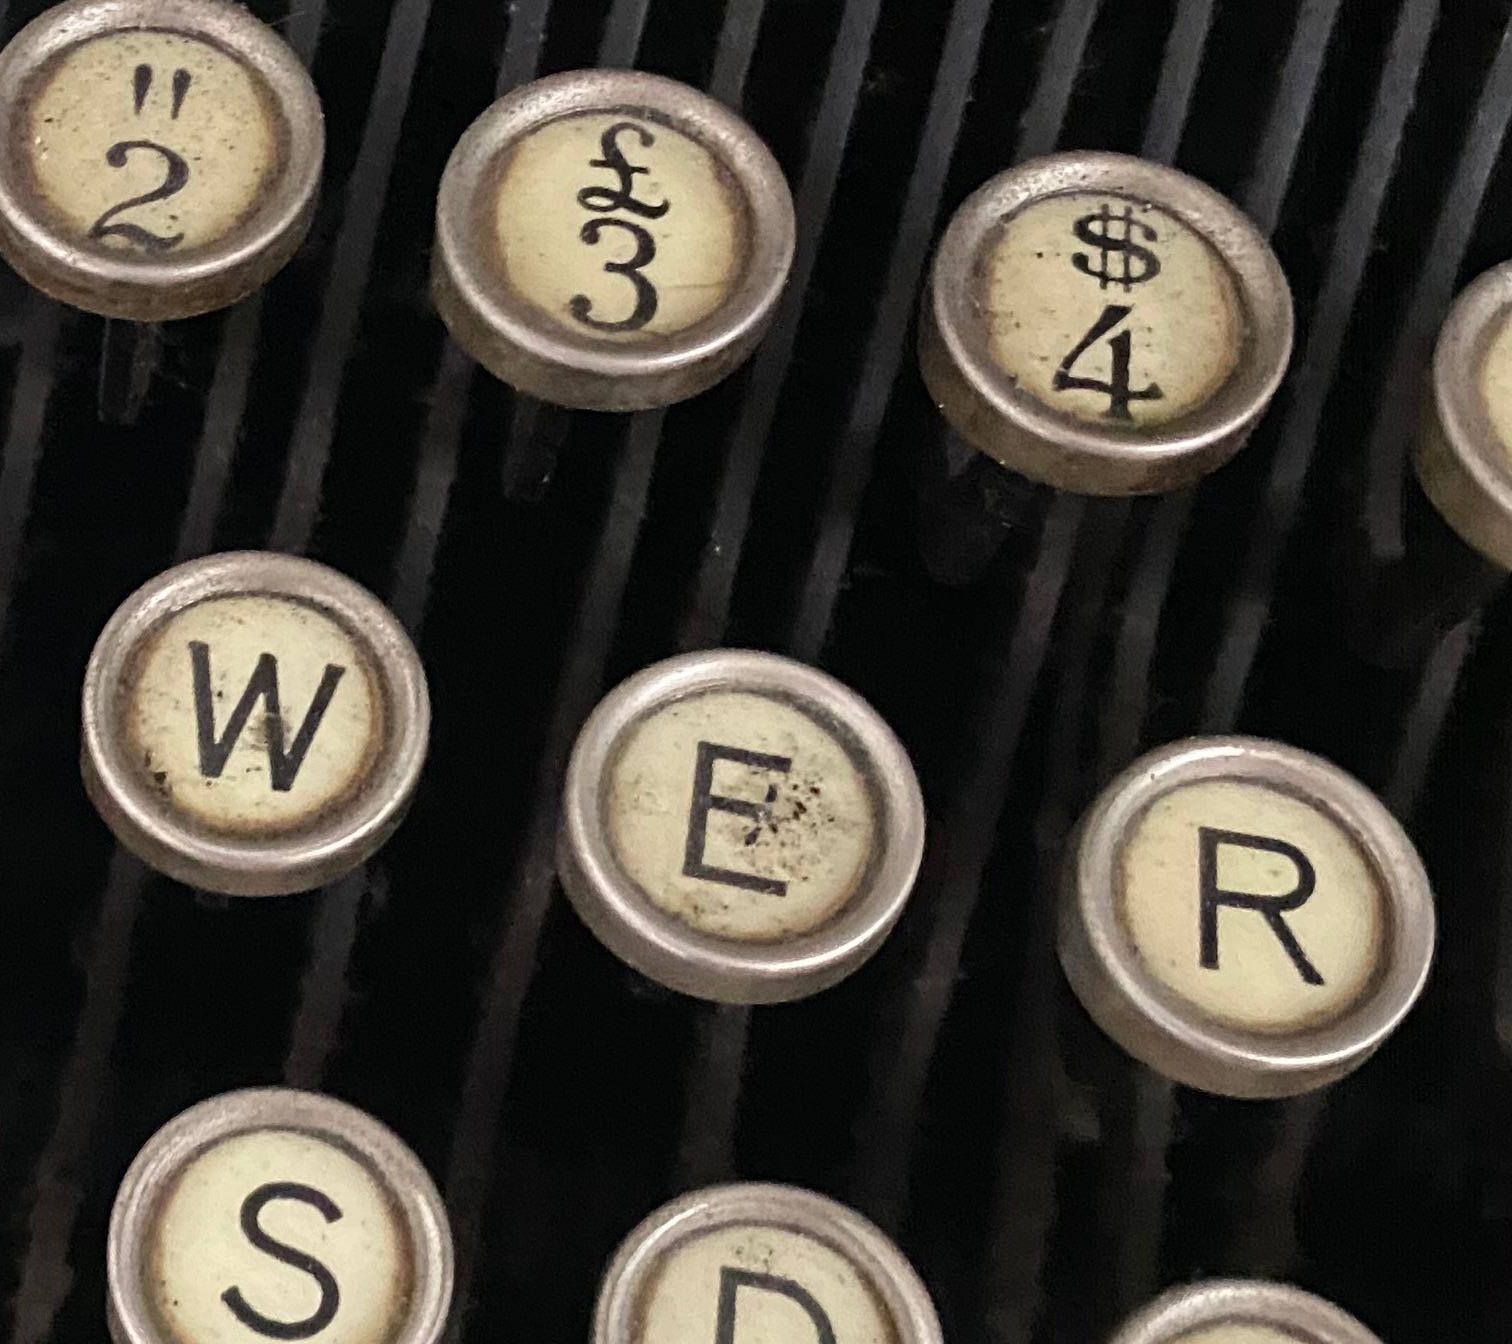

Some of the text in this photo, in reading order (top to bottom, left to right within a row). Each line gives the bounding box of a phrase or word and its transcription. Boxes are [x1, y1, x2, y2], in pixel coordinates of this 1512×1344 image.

[90, 140, 190, 251] 2
[577, 122, 671, 220] £
[569, 218, 660, 332] 3
[1071, 203, 1162, 292] $
[1053, 305, 1164, 420] 4
[187, 640, 347, 793] W
[681, 740, 794, 897] E
[1197, 825, 1326, 986] R
[220, 1181, 344, 1341] S
